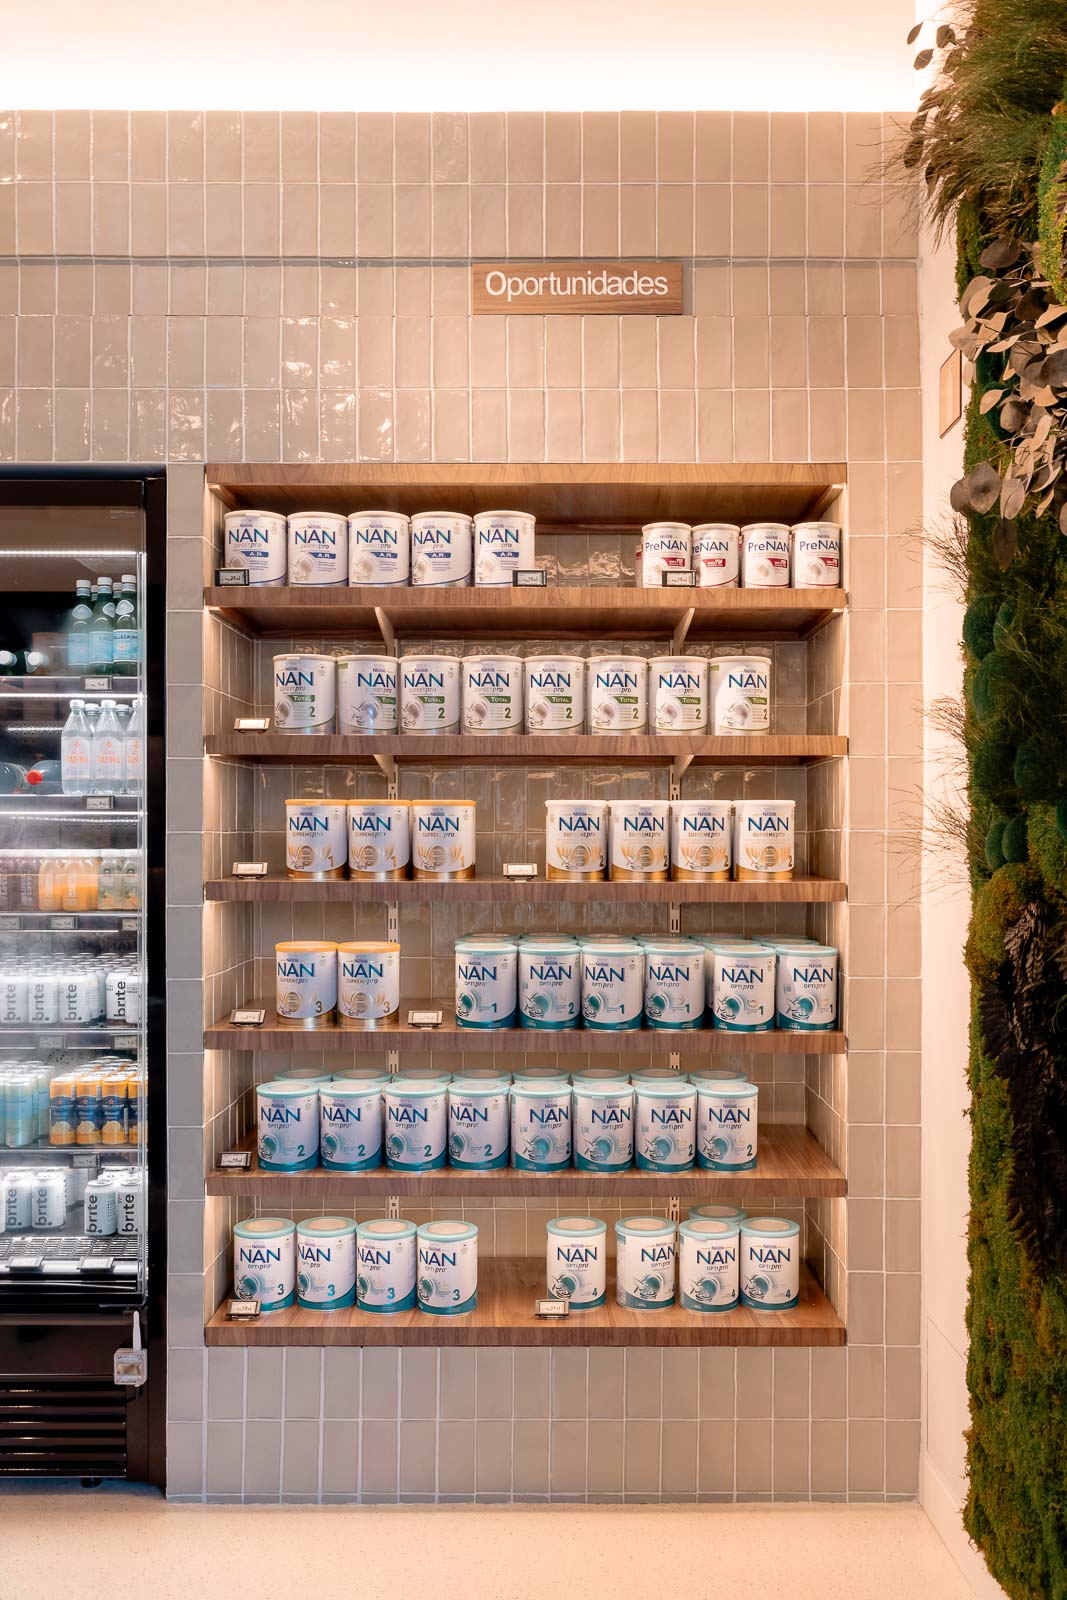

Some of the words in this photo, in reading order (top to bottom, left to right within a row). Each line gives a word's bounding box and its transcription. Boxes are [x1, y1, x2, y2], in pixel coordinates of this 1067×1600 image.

[485, 271, 669, 302] Oportunidades
[229, 528, 268, 544] NAN
[295, 530, 335, 545] NAN
[357, 530, 397, 544] NAN
[414, 530, 450, 546] NAN
[480, 529, 518, 544] NAN
[692, 541, 728, 553] reNAN
[748, 542, 789, 552] PreNAN
[276, 672, 313, 686] NAN
[358, 673, 396, 687] NAN
[404, 674, 443, 688] NAN
[469, 673, 509, 687] NAN
[530, 674, 570, 688] NAN
[597, 674, 637, 688] NAN
[660, 675, 700, 688] NAN
[729, 674, 767, 688] NAN
[309, 706, 315, 717] 2
[438, 707, 445, 718] 2
[505, 707, 511, 718] 2
[566, 707, 572, 719] 2
[633, 708, 638, 719] 2
[696, 709, 701, 719] 2
[289, 817, 329, 832] NAN
[352, 817, 391, 832] NAN
[418, 817, 459, 832] NAN
[559, 817, 599, 831] NAN
[624, 817, 664, 831] NAN
[683, 817, 724, 831] NAN
[748, 817, 789, 831] NAN
[328, 856, 334, 867] 1
[391, 856, 397, 868] 1
[664, 855, 667, 867] 2
[724, 856, 729, 867] 2
[788, 856, 792, 867] 2
[277, 962, 314, 978] NAN
[343, 963, 383, 978] NAN
[458, 965, 497, 980] NAN
[530, 965, 571, 980] NAN
[585, 966, 624, 981] NAN
[649, 966, 689, 981] NAN
[722, 968, 763, 983] NAN
[794, 968, 833, 982] NAN
[315, 1001, 323, 1013] 3
[384, 1002, 390, 1013] 3
[492, 1003, 497, 1012] 1
[568, 1002, 574, 1014] 2
[619, 1005, 624, 1014] 1
[685, 1004, 690, 1014] 1
[759, 1005, 763, 1015] 1
[261, 1107, 300, 1122] NAN
[323, 1106, 360, 1122] NAN
[388, 1106, 427, 1122] NAN
[450, 1106, 488, 1121] NAN
[530, 1106, 568, 1123] NAN
[592, 1107, 630, 1123] NAN
[651, 1108, 691, 1123] NAN
[709, 1108, 750, 1123] NAN
[297, 1145, 305, 1156] 2
[358, 1145, 366, 1156] 2
[424, 1145, 432, 1157] 2
[484, 1144, 492, 1156] 2
[628, 1143, 632, 1156] 2
[688, 1144, 693, 1156] 2
[747, 1144, 752, 1156] 2
[240, 1248, 280, 1263] NAN
[298, 1245, 331, 1262] NAN
[358, 1248, 390, 1264] NAN
[420, 1248, 456, 1266] NAN
[557, 1247, 597, 1262] NAN
[641, 1246, 675, 1262] NAN
[696, 1248, 735, 1264] NAN
[750, 1247, 790, 1263] NAN
[277, 1284, 284, 1295] 3
[328, 1284, 335, 1296] 3
[387, 1288, 395, 1299] 3
[453, 1289, 460, 1301] 3
[592, 1288, 598, 1296] 4
[731, 1289, 736, 1298] 4
[786, 1289, 791, 1298] 4
